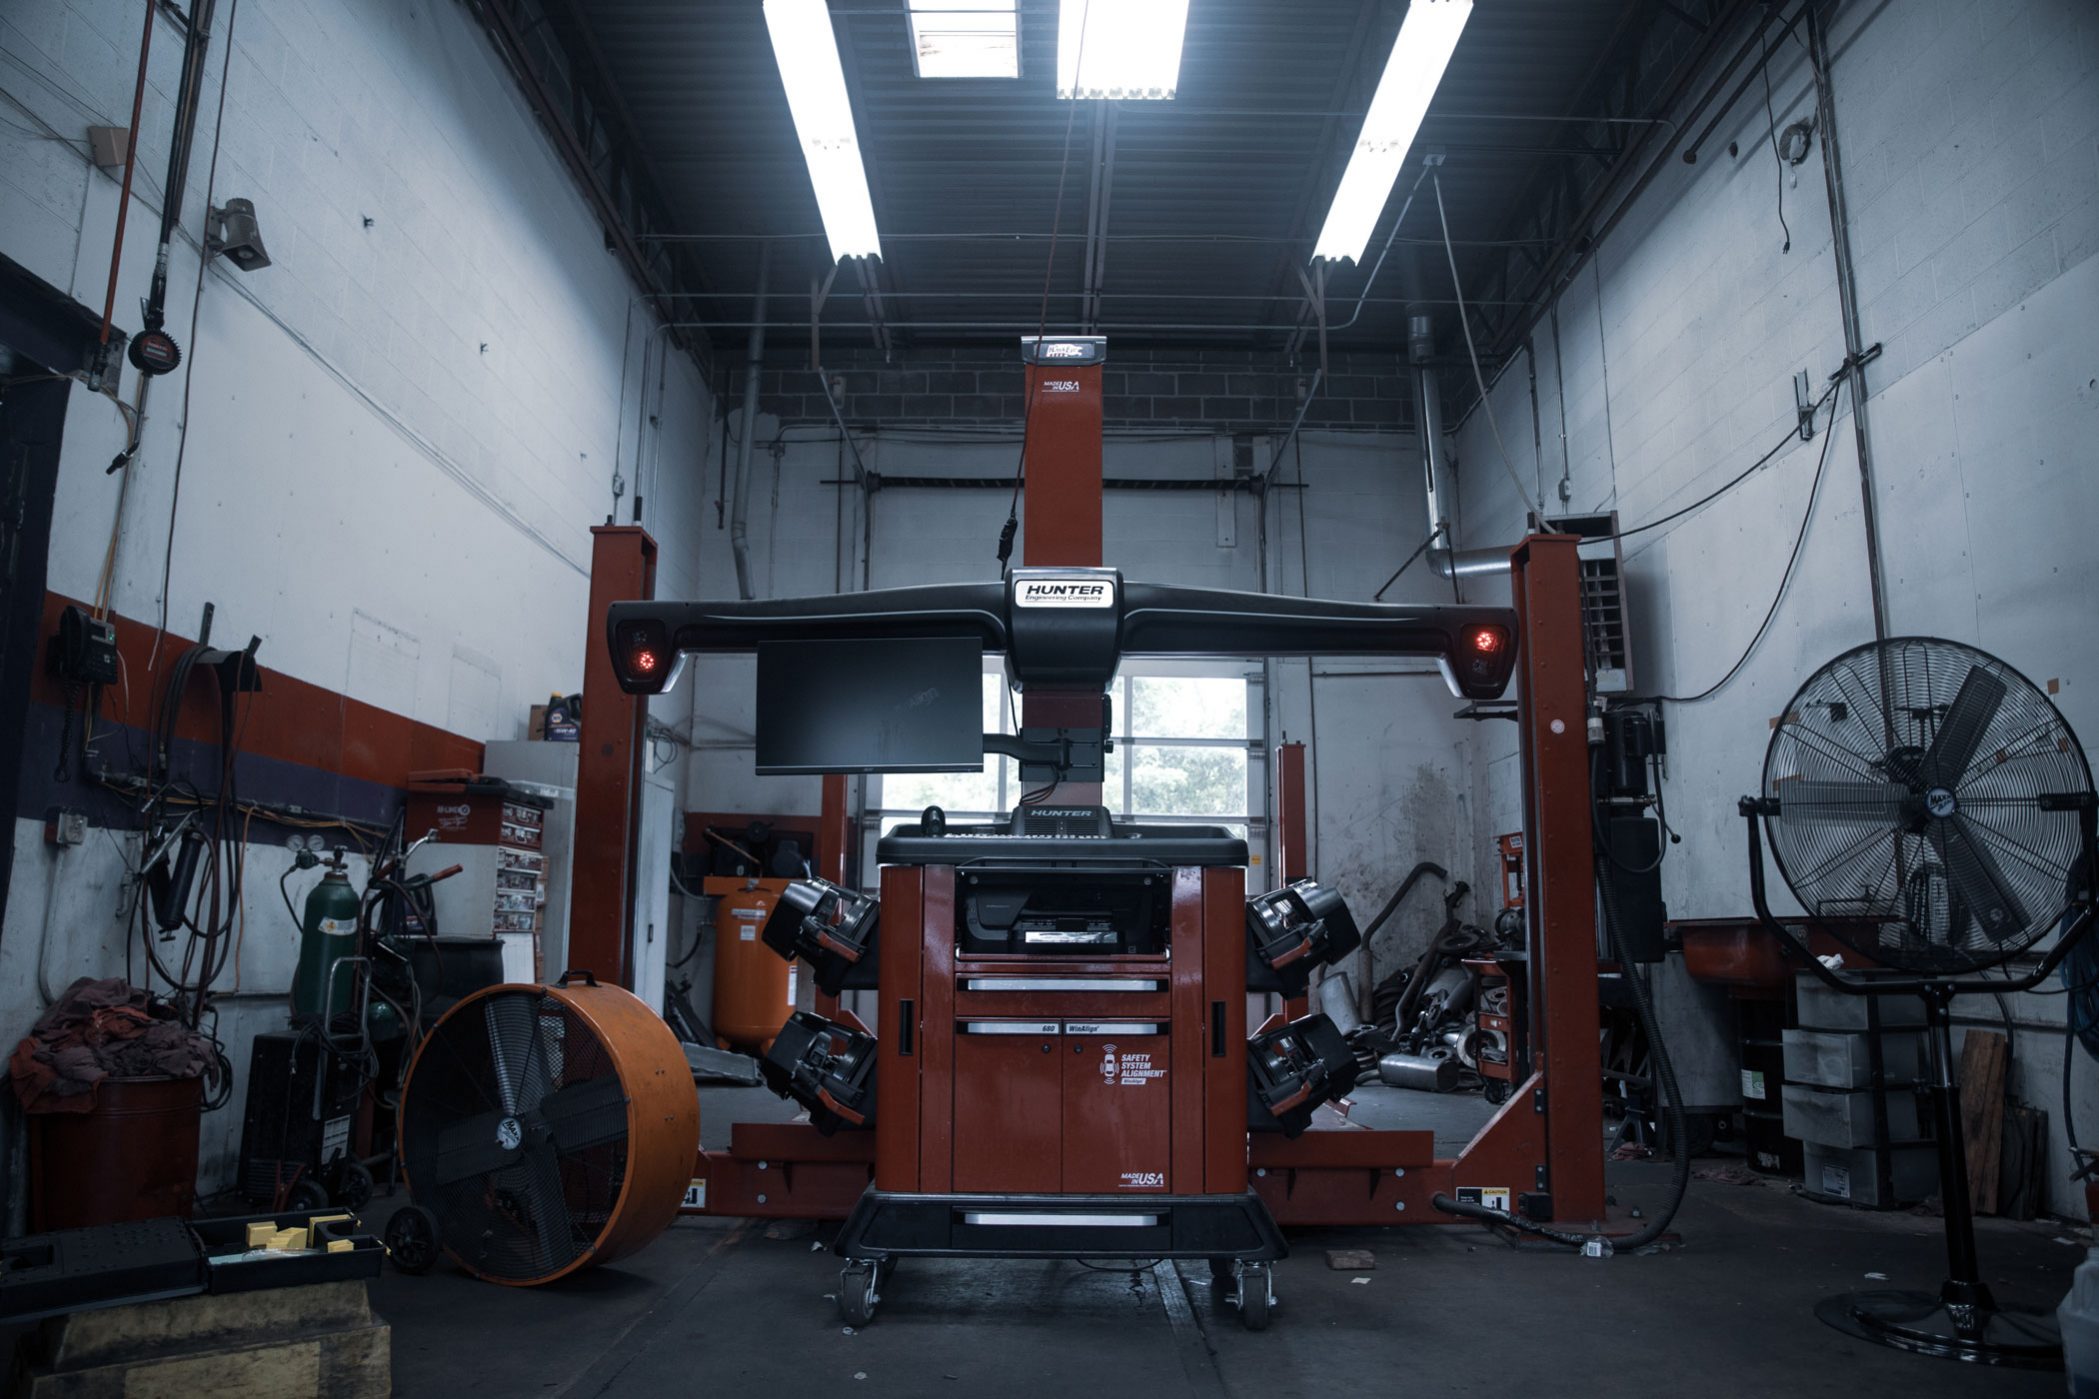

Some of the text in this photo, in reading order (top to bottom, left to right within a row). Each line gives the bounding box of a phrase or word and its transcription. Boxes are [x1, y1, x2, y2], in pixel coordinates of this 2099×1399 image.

[1059, 381, 1080, 390] USA
[1027, 585, 1104, 595] HUNTER
[1031, 809, 1092, 817] HUNTER
[1138, 1172, 1164, 1185] USA
